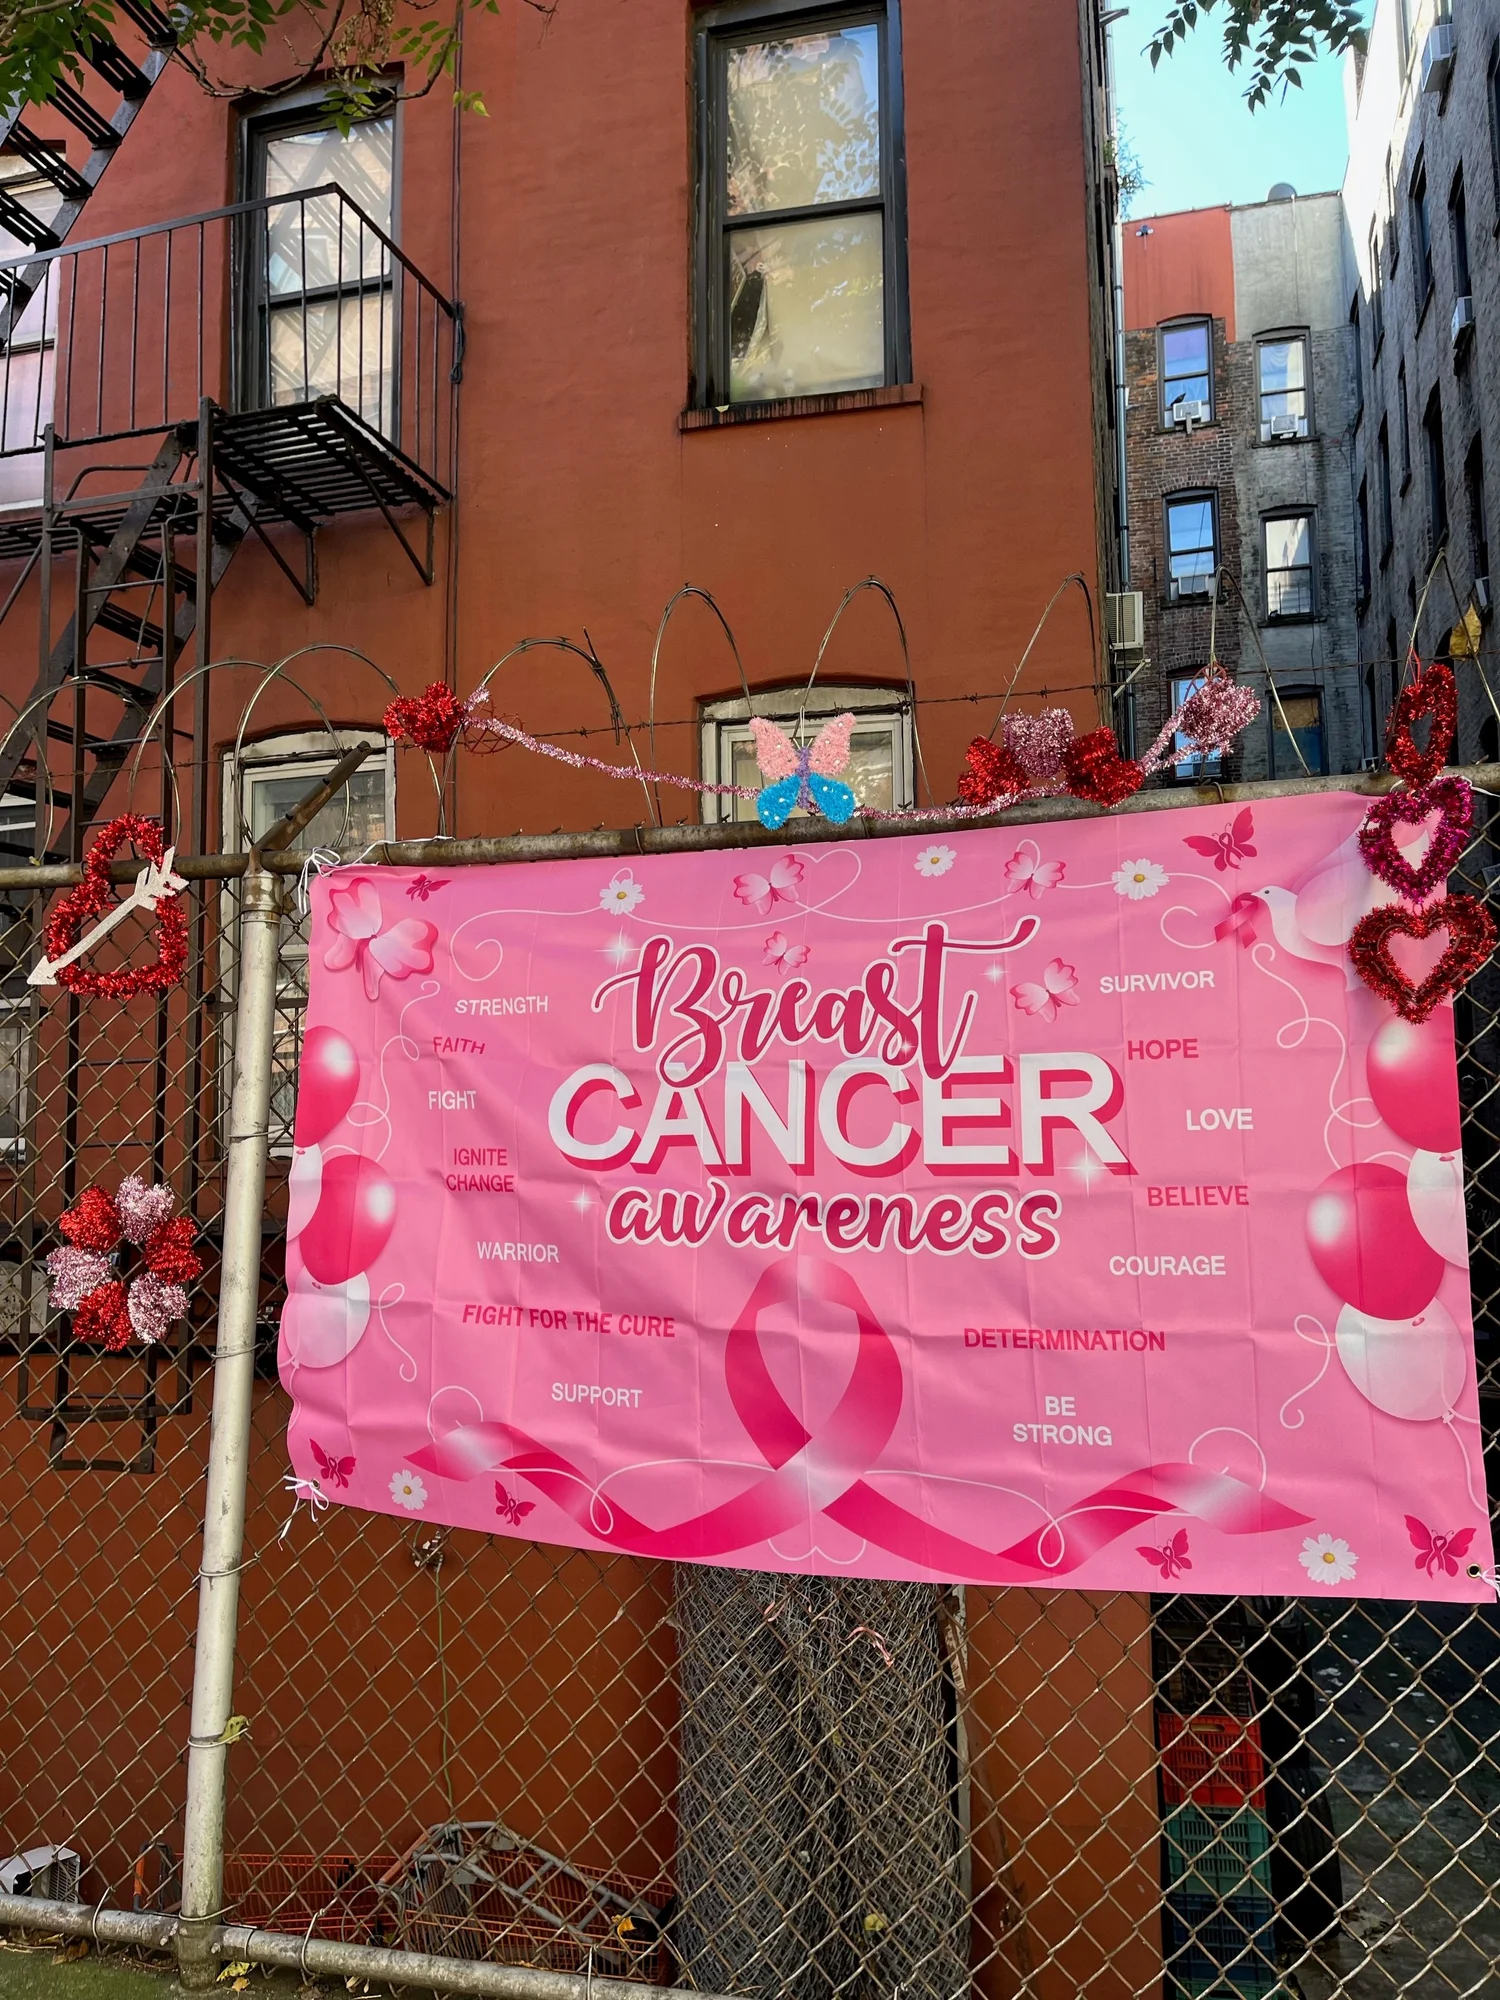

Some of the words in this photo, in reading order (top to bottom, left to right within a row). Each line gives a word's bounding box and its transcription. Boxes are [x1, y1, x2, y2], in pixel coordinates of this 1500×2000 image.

[1100, 970, 1215, 994] SURVIVOR
[455, 995, 549, 1016] STRENGTH
[592, 914, 1040, 1087] Breast
[433, 1036, 486, 1055] FAITH
[1127, 1038, 1199, 1061] HOPE
[428, 1090, 477, 1110] FIGHT
[548, 1052, 1138, 1177] CANCER
[1186, 1108, 1254, 1131] LOVE
[453, 1148, 508, 1166] IGNITE
[445, 1173, 515, 1193] CHANGE
[1147, 1185, 1250, 1207] BELIEVE
[605, 1177, 1061, 1259] awareness
[476, 1240, 560, 1264] WARRIOR
[1109, 1255, 1226, 1276] COURAGE
[462, 1304, 524, 1327] FIGHT
[528, 1308, 568, 1331] FOR
[572, 1310, 612, 1334] THE
[618, 1313, 676, 1338] CURE
[964, 1327, 1166, 1352] DETERMINATION
[551, 1382, 643, 1409] SUPPORT
[1045, 1395, 1077, 1417] BE
[1012, 1423, 1113, 1447] STRONG
